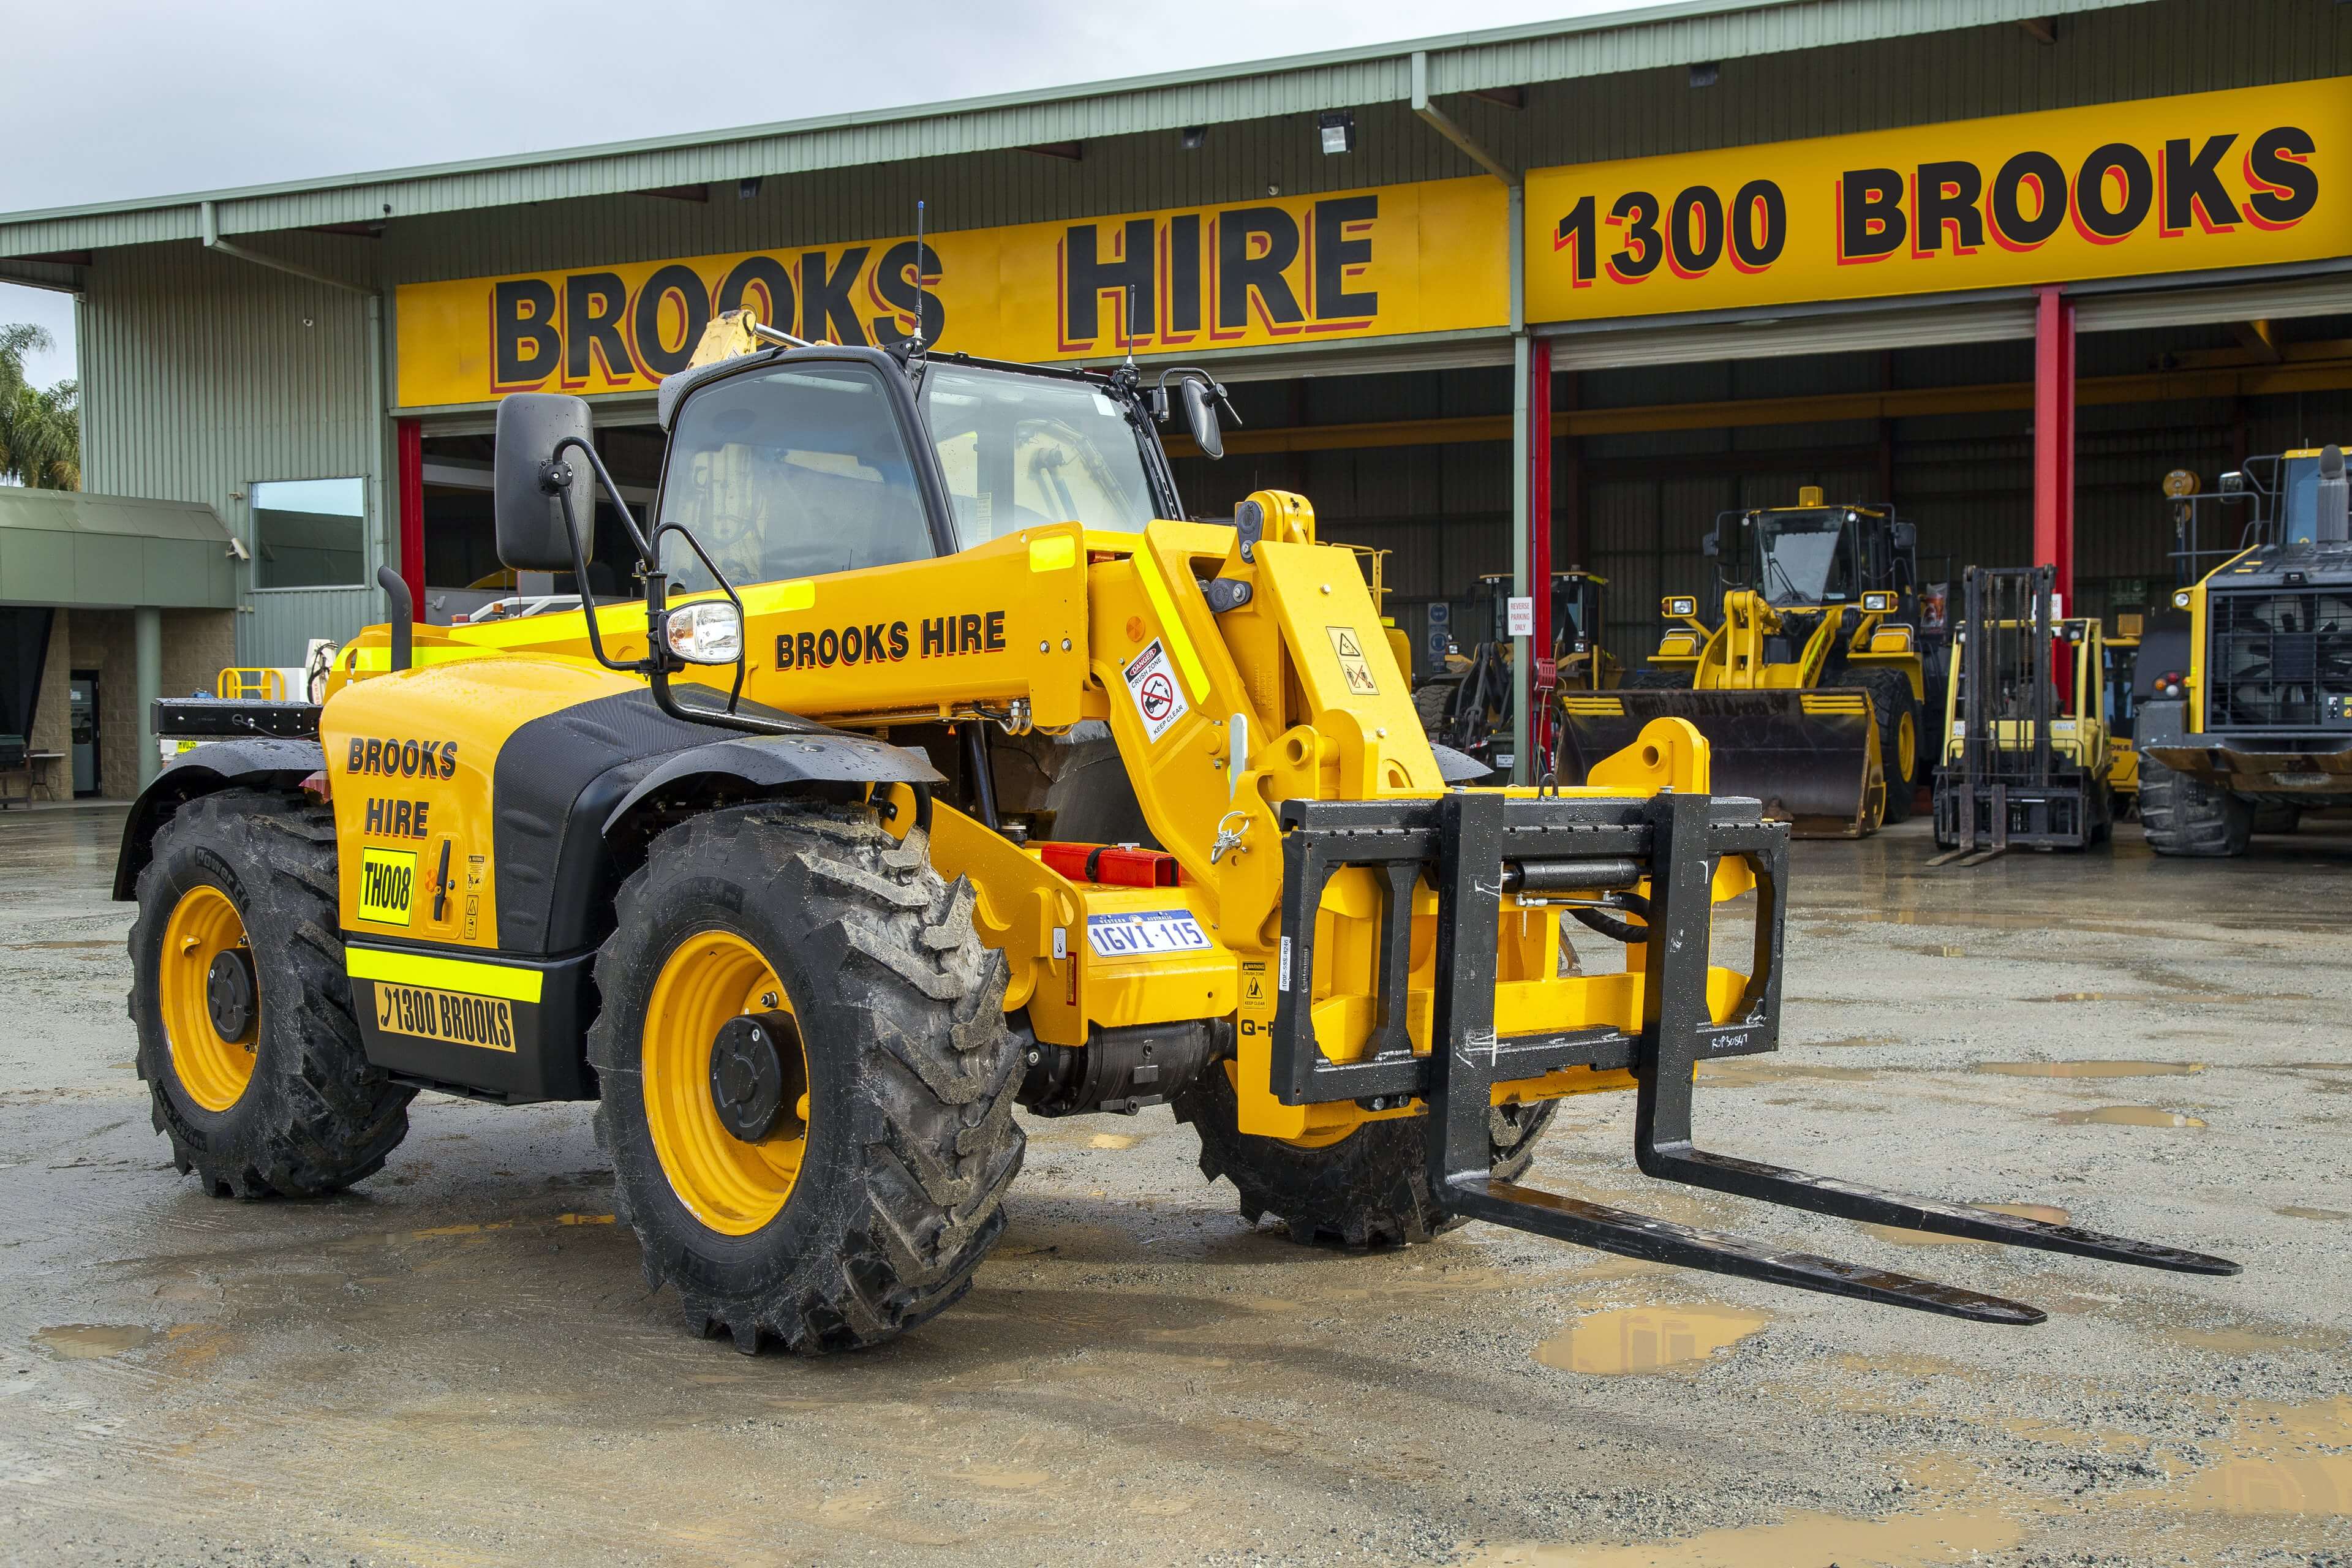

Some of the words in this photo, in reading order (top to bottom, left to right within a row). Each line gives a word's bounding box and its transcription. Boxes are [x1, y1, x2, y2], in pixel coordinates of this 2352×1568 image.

[1554, 179, 1787, 287] 1300
[1836, 126, 2319, 265] BROOKS
[490, 241, 945, 394] BROOKS
[1058, 195, 1378, 352] HIRE
[775, 620, 909, 672] BROOKS
[921, 611, 1006, 658] HIRE
[1133, 650, 1155, 673] DANGER
[1131, 671, 1148, 688] CRUSH
[1148, 656, 1162, 673] ZONE
[1153, 720, 1166, 735] KEEP
[1166, 705, 1183, 723] CLEAR
[346, 737, 458, 781] BROOKS
[364, 798, 429, 840] HIRE
[364, 861, 411, 911] TH008
[391, 987, 436, 1035] 1300
[440, 994, 511, 1048] BROOKS
